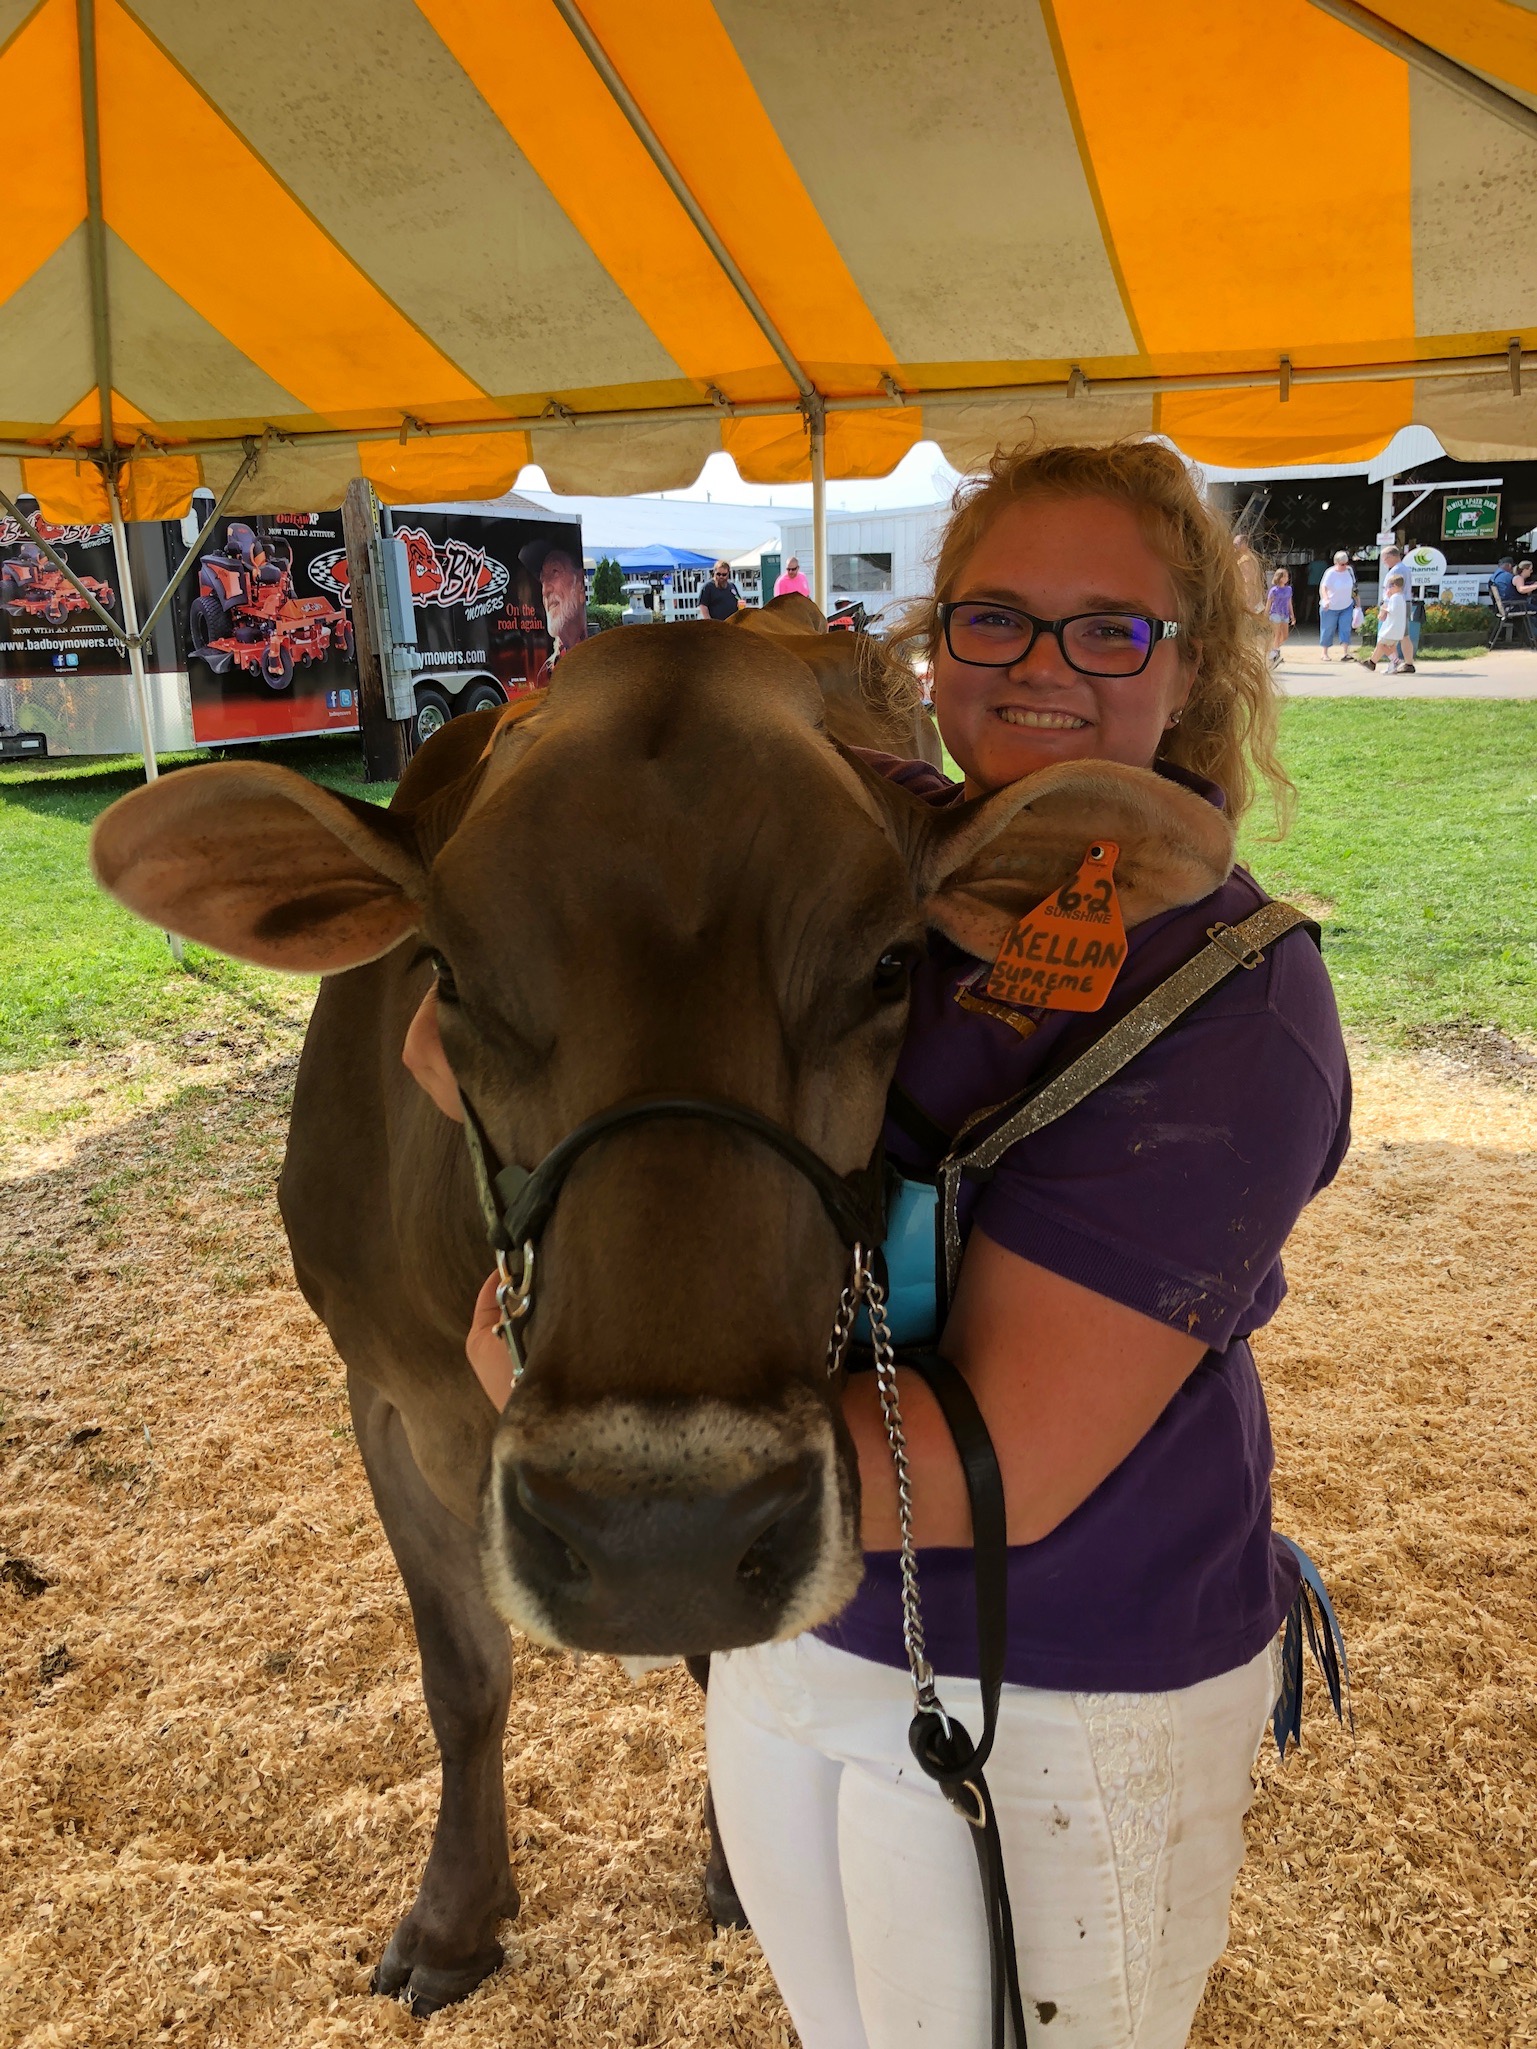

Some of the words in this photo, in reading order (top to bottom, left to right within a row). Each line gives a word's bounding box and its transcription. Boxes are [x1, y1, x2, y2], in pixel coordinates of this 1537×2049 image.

[299, 529, 308, 537] AN
[309, 530, 336, 538] ATTITUDE
[465, 596, 505, 621] MOWERS
[506, 603, 520, 617] On
[522, 603, 536, 617] the
[12, 628, 31, 636] MOW
[70, 624, 109, 634] ATTITUDE
[497, 617, 518, 630] road
[520, 617, 546, 633] again.
[1043, 905, 1113, 925] SUNSHINE
[1002, 922, 1126, 970] KELLAN
[991, 960, 1094, 993] SUPREME
[989, 980, 1053, 1006] ZEUS
